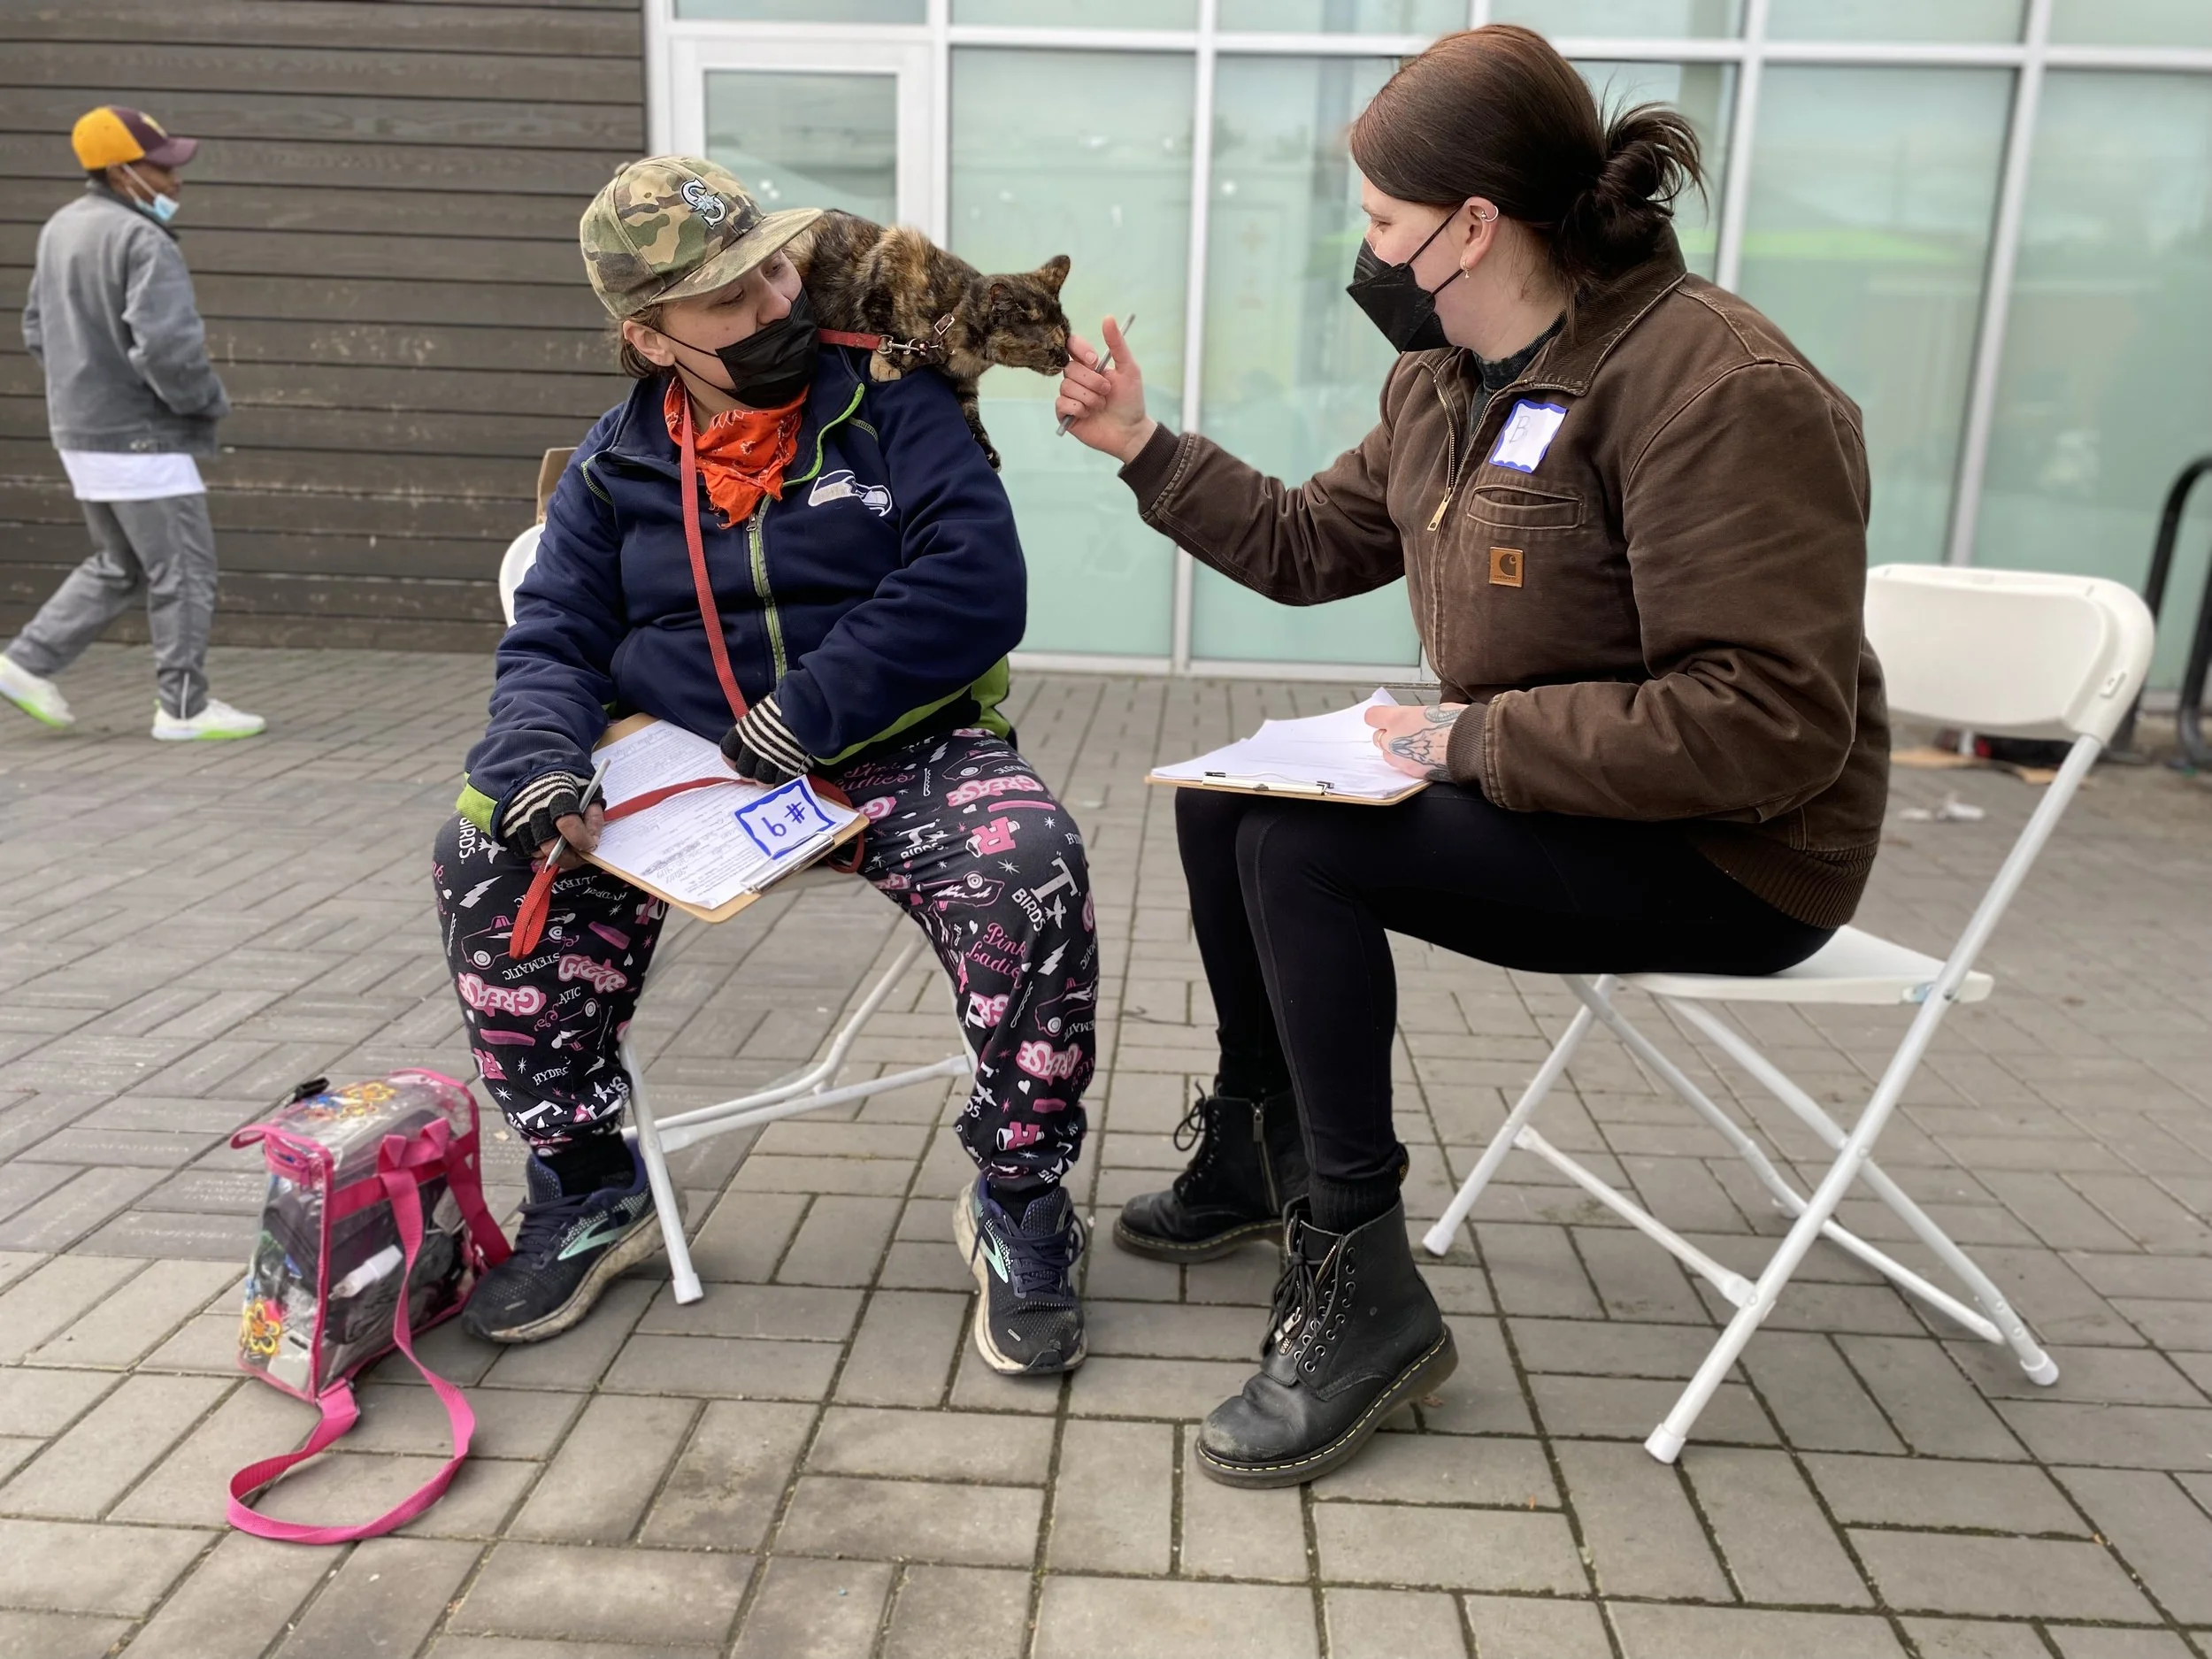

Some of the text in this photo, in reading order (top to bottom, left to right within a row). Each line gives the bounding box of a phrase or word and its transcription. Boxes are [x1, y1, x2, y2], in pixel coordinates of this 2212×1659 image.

[761, 802, 805, 837] #9
[1011, 887, 1047, 933] BIRDS
[982, 922, 1027, 958] Pink
[502, 952, 561, 981] STEMATIC
